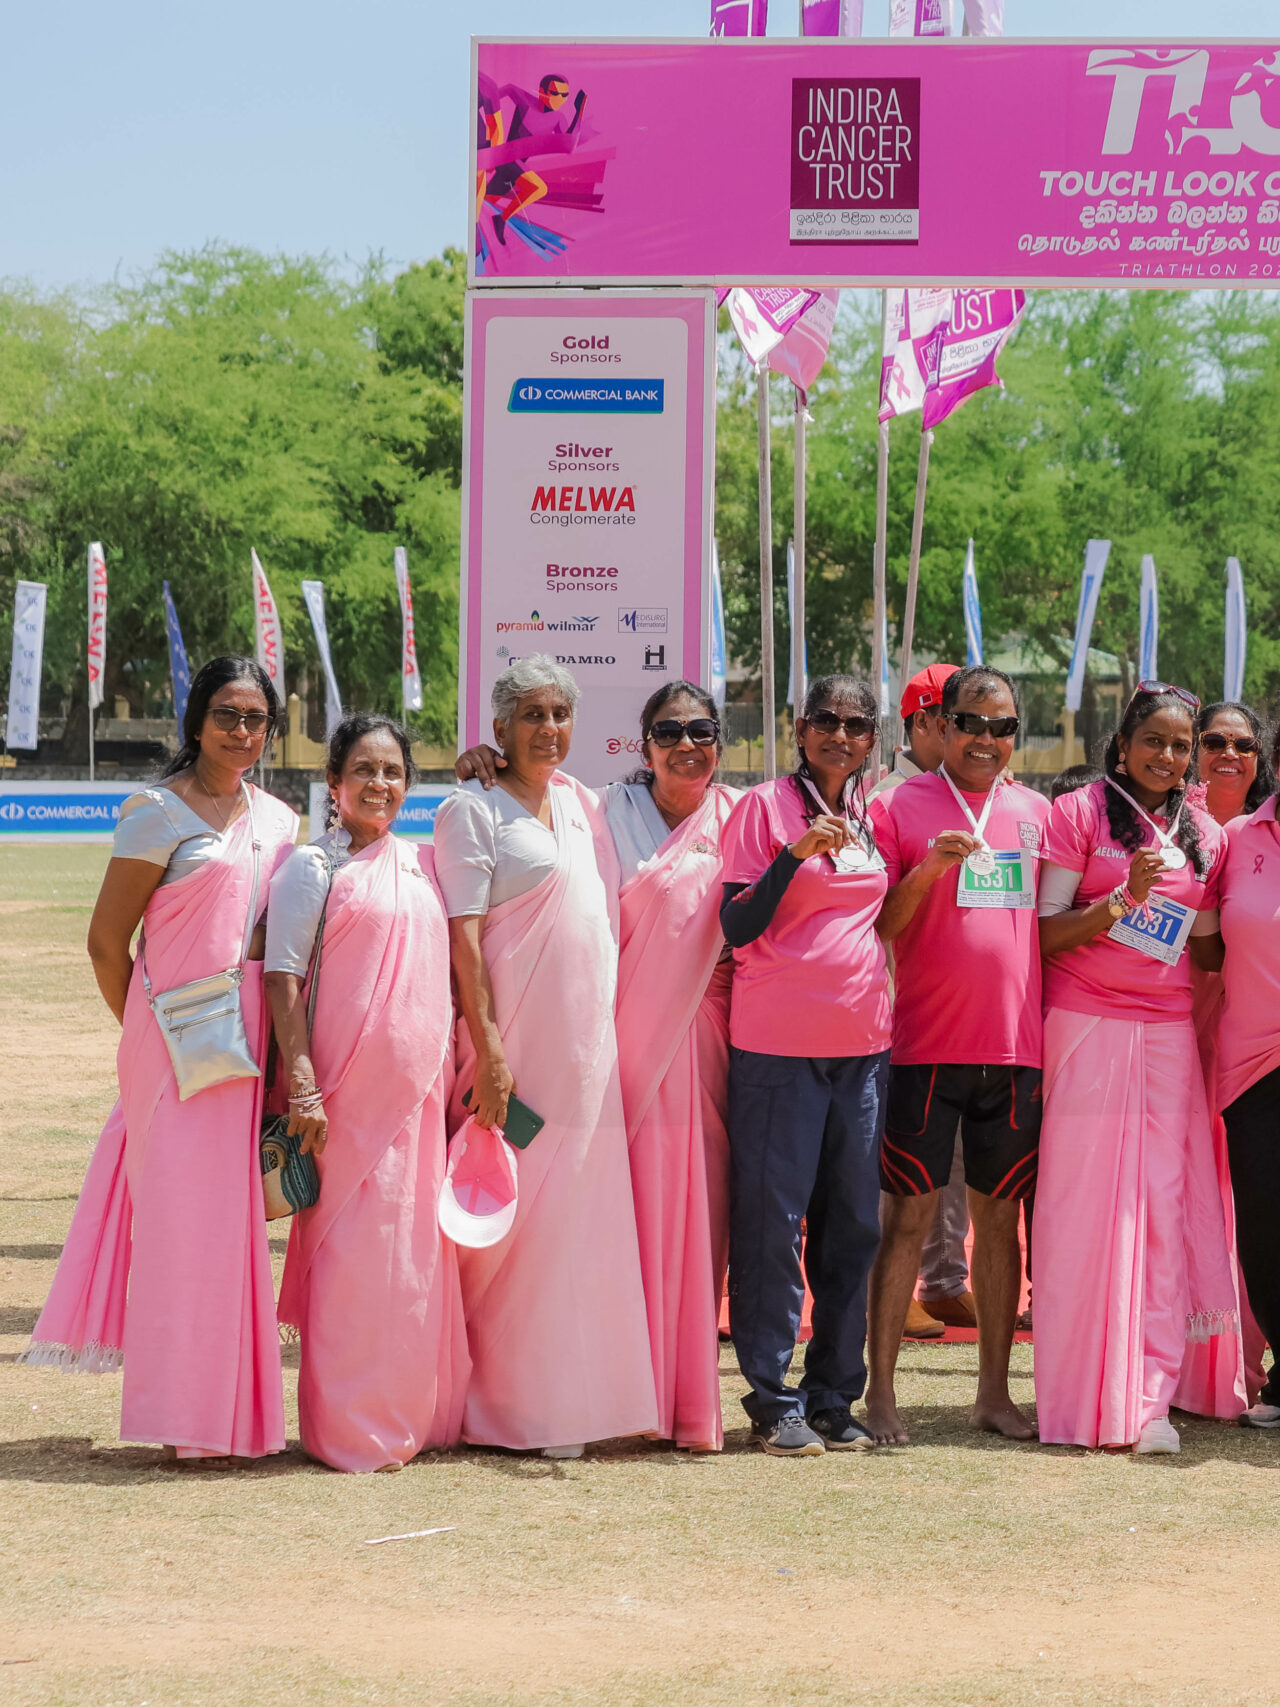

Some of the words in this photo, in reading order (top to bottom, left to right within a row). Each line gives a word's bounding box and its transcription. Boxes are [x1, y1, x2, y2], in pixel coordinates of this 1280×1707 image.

[808, 87, 903, 124] INDIRA
[798, 125, 912, 162] CANCER
[808, 163, 902, 200] TRUST
[1038, 170, 1159, 197] TOUCH
[1162, 170, 1261, 197] LOOK
[1118, 263, 1238, 276] TRIATHLON
[562, 335, 610, 350] Gold
[549, 351, 622, 365] Sponsors
[545, 389, 623, 401] COMMERCIAL
[625, 390, 659, 401] BANK
[555, 443, 613, 458] Silver
[547, 460, 620, 473] Sponsors
[531, 486, 637, 512] MELWA
[530, 512, 636, 527] Conglomerate
[546, 563, 619, 578] Bronze
[546, 580, 618, 593] Sponsors
[496, 621, 544, 633] pyramid
[547, 621, 596, 631] wilmar
[556, 656, 616, 665] DAMRO
[26, 806, 110, 819] COMMERCIAL
